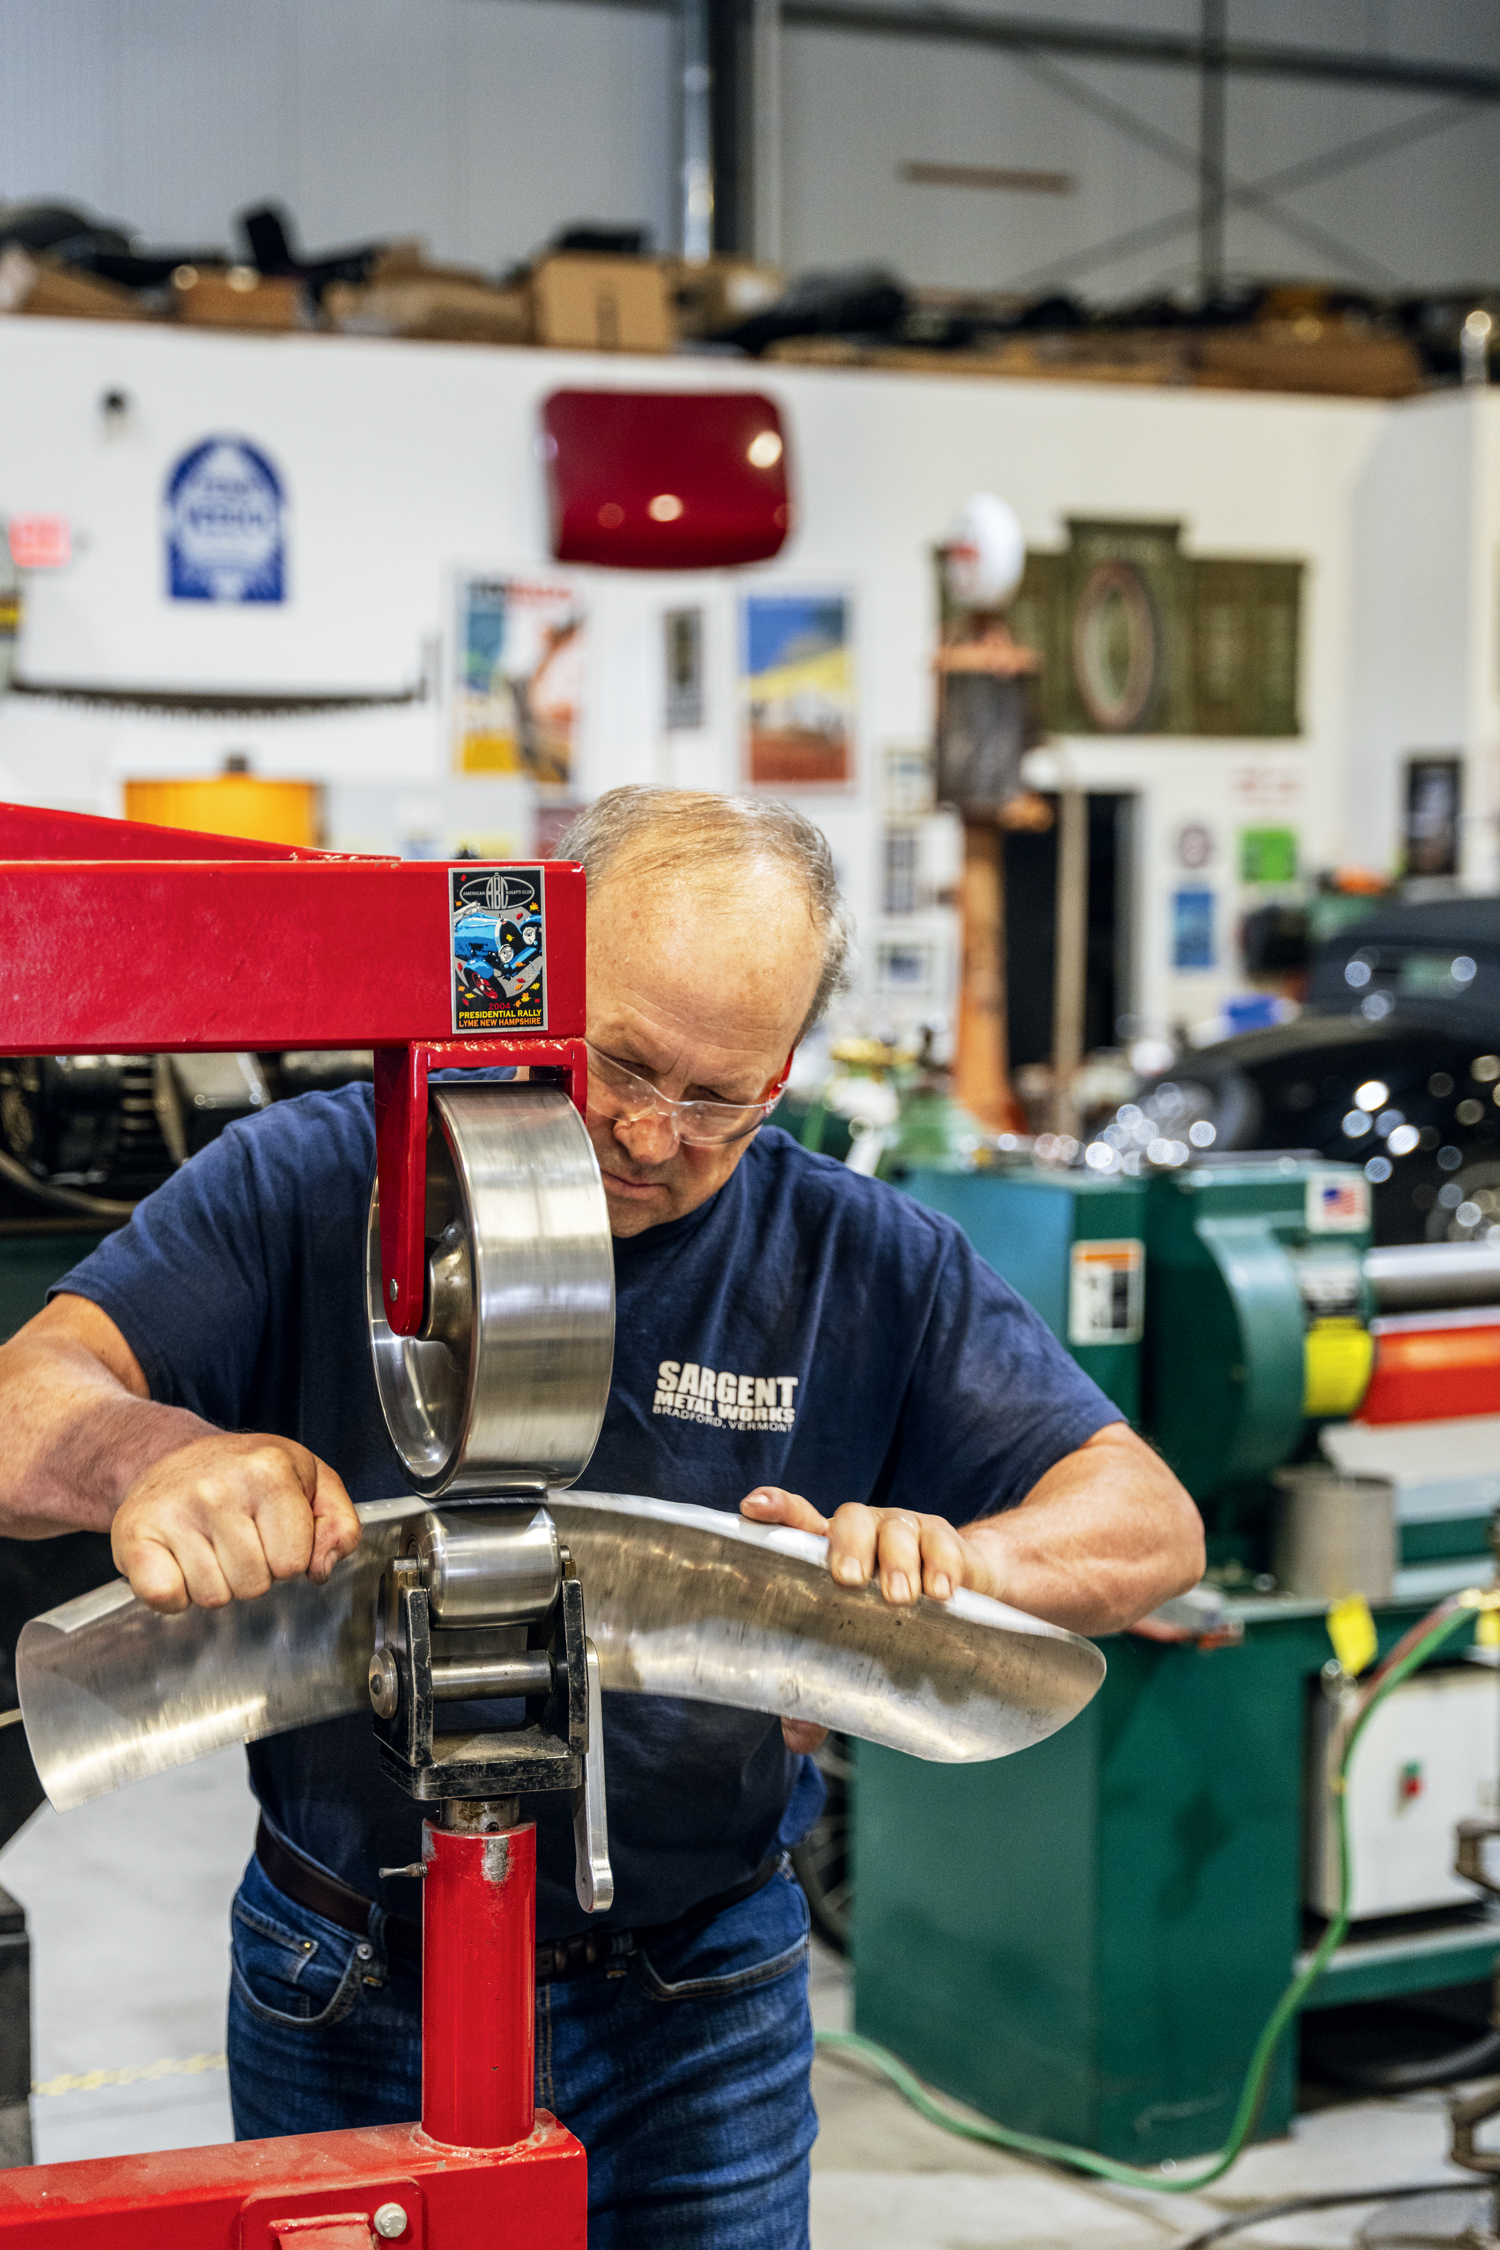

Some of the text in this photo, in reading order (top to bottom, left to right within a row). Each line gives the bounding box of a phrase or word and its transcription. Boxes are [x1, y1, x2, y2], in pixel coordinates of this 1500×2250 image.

[459, 1009, 542, 1019] PRESIDENTIAL RALLY
[499, 1017, 542, 1026] HAMPSHIRE
[656, 1360, 799, 1408] SARGENT
[653, 1389, 796, 1424] METAL WORKS
[727, 1419, 794, 1433] VERMONT
